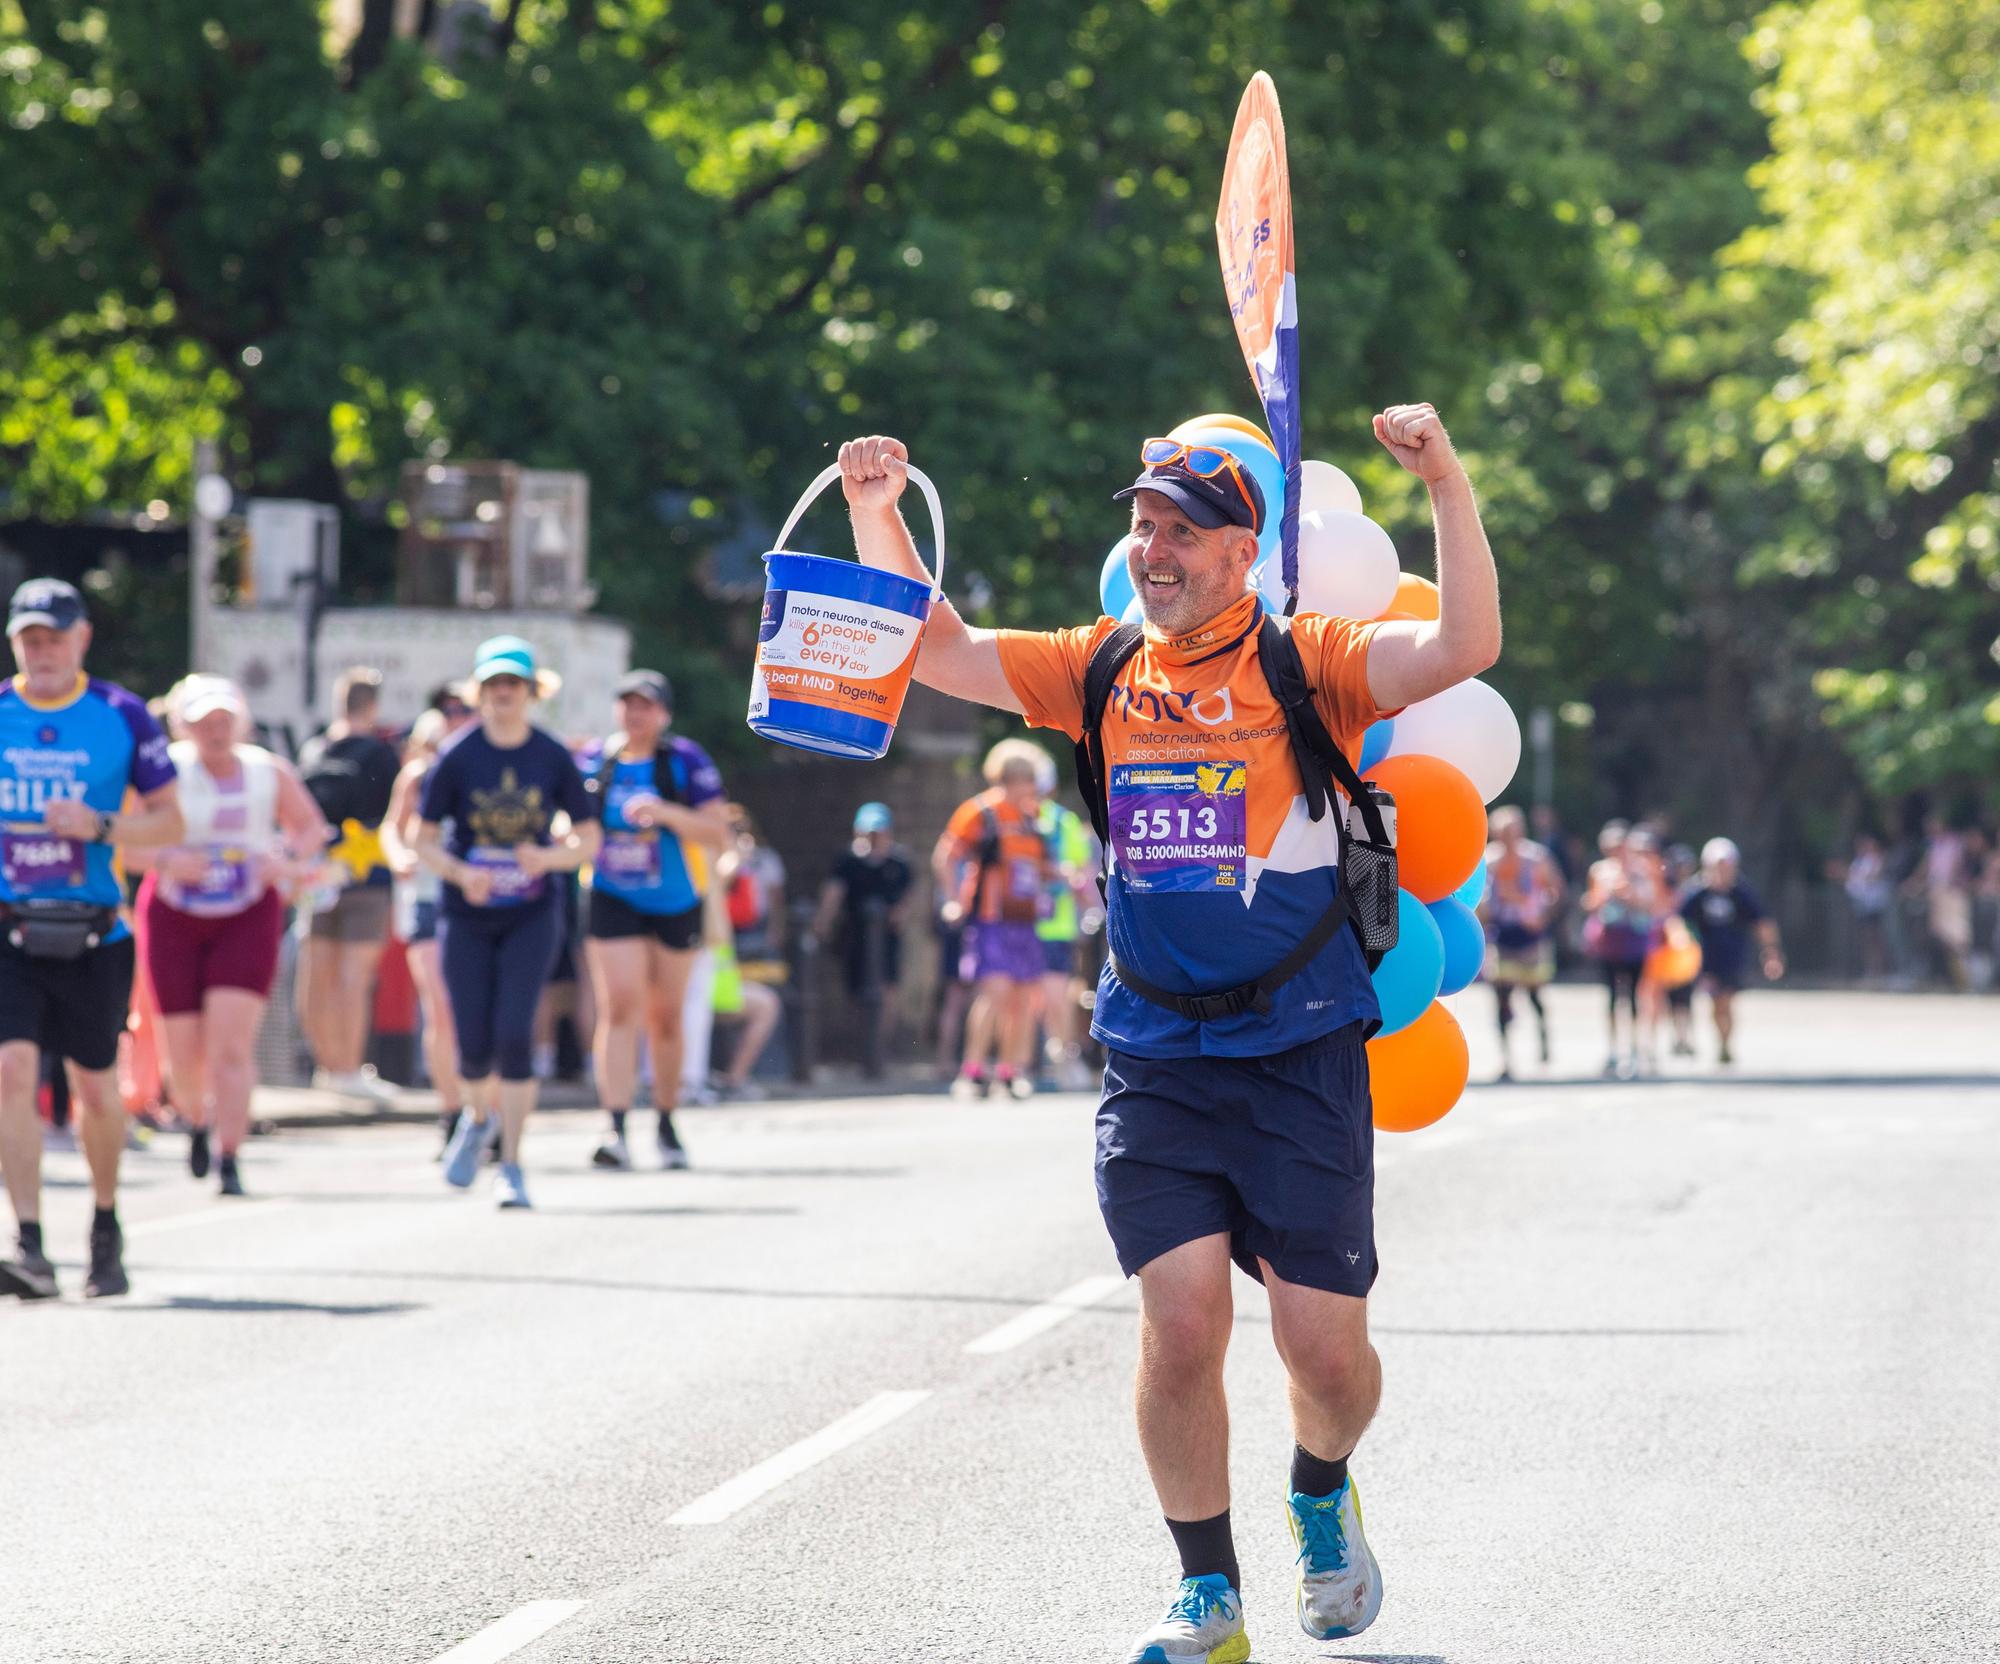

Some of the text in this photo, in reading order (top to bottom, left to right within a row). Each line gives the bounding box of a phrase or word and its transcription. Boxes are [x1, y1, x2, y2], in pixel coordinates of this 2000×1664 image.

[789, 618, 805, 630] kills
[792, 606, 905, 637] motor neurone disease
[802, 622, 877, 646] 6 people
[819, 639, 869, 657] in the UK
[800, 648, 869, 674] every day
[772, 670, 799, 685] beat
[802, 674, 835, 691] MND
[838, 682, 888, 704] together
[1129, 721, 1287, 745] motor neurone disease
[1127, 747, 1205, 761] association
[1214, 768, 1234, 792] 7
[1129, 807, 1218, 841] 5513
[1126, 845, 1246, 860] ROB 5000MILES4MND
